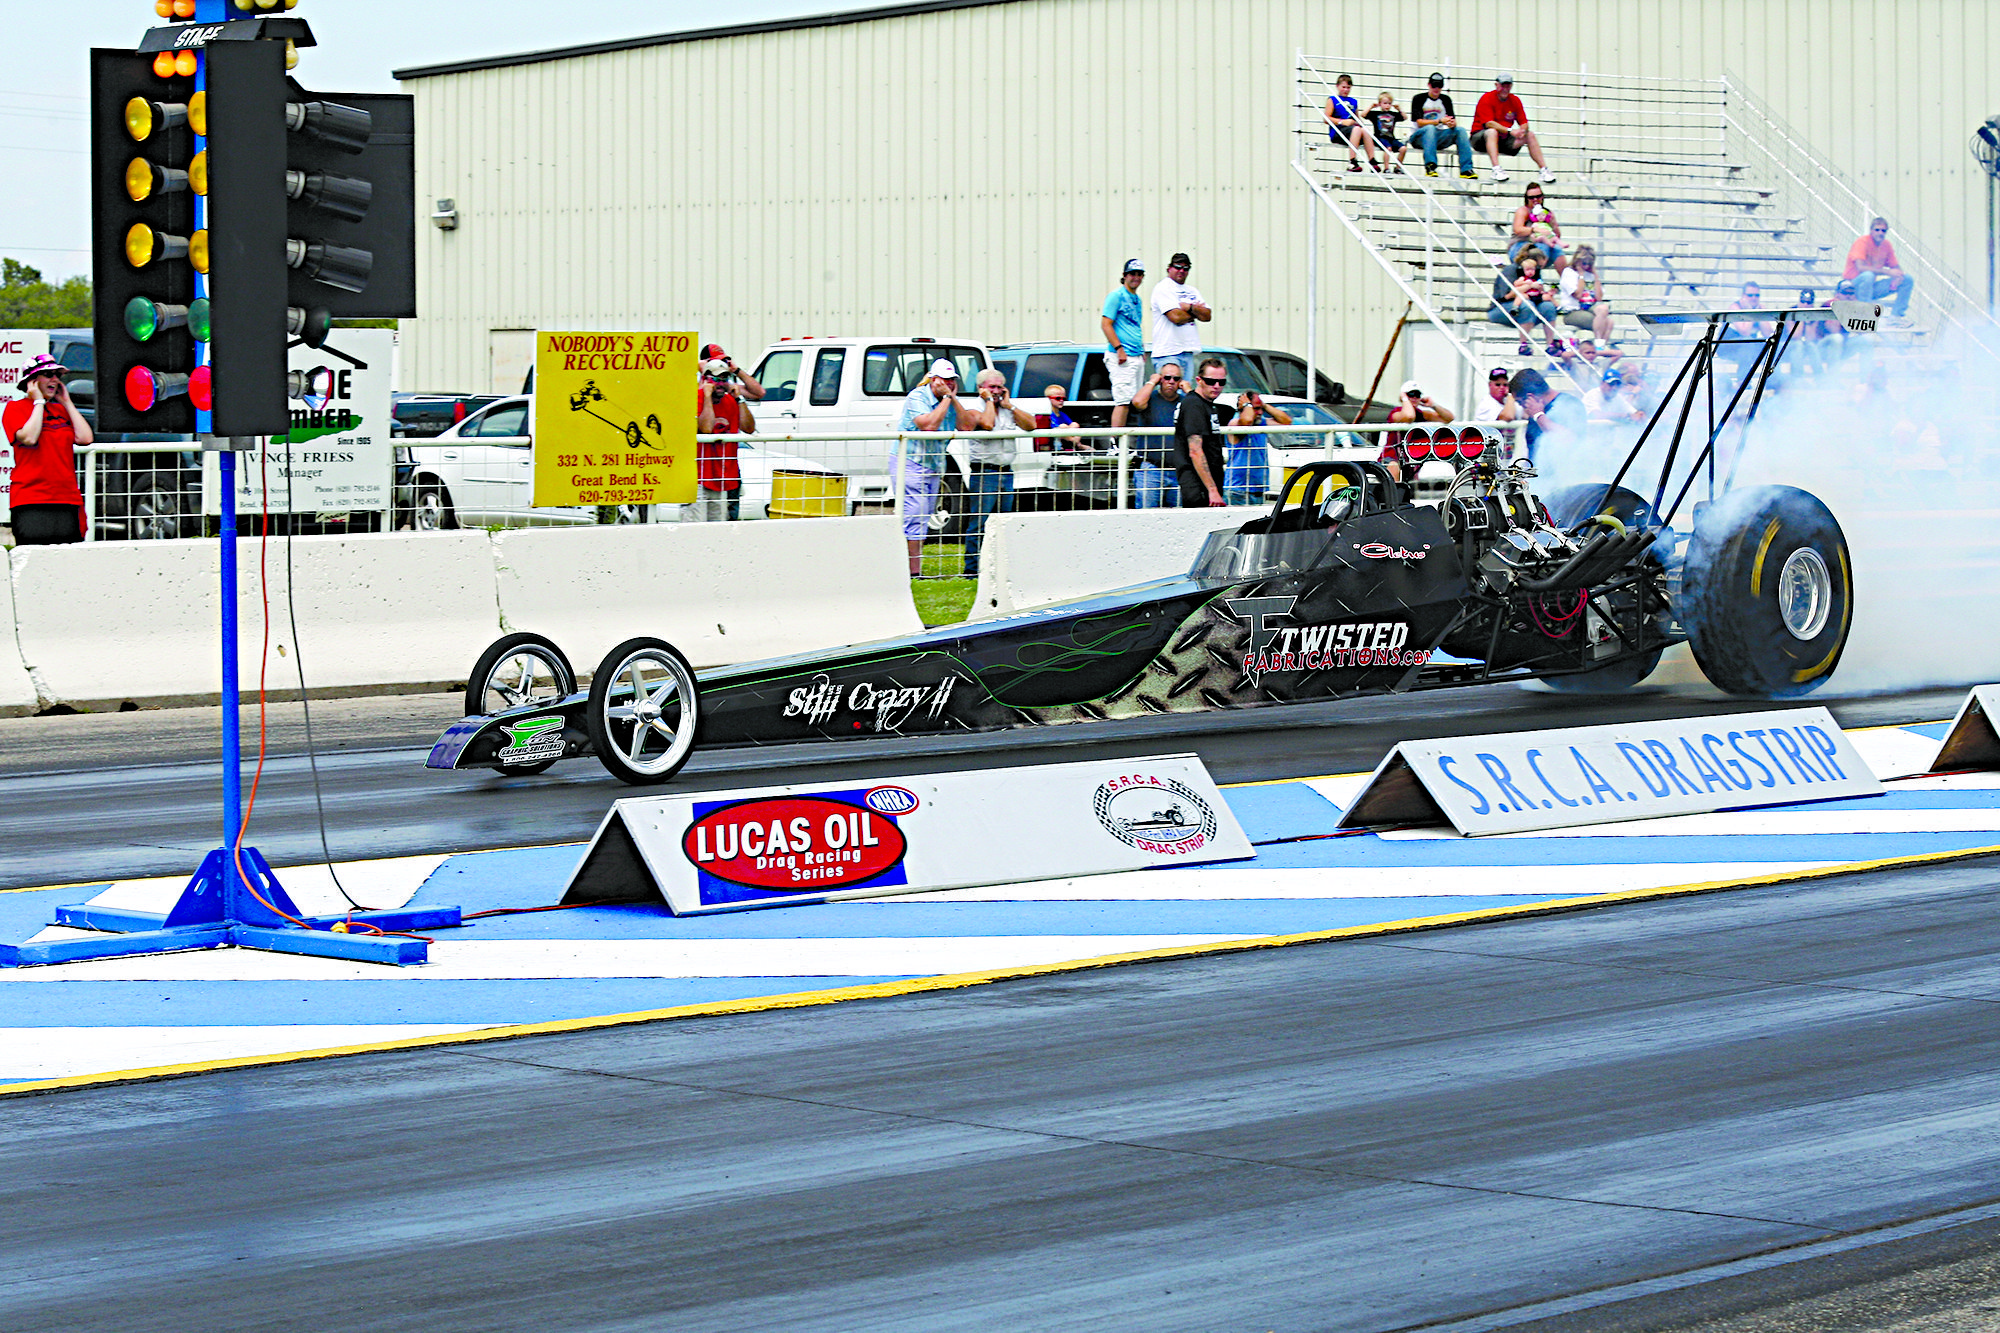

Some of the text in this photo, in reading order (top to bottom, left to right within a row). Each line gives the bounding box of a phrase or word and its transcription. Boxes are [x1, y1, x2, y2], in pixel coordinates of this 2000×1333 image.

[1847, 318, 1876, 332] 4764
[0, 341, 22, 354] MC
[547, 335, 690, 352] NOBODY'S AUTO
[563, 353, 666, 371] RECYCLING
[289, 408, 351, 429] MBER
[337, 437, 354, 445] Since
[249, 452, 354, 463] VNCE FRIESS
[557, 453, 675, 468] 332 N. 281 Highway
[571, 473, 661, 487] Great Bend Ks.
[579, 488, 655, 503] 620-793-2257
[1280, 622, 1409, 656] TWISTED
[848, 682, 931, 733] Crazy
[1437, 724, 1848, 817] S.R.C.A. DRAGSTRIP
[1108, 774, 1166, 791] S.R.C.A.
[870, 790, 913, 812] NHRA
[697, 812, 879, 863] LUCAS OIL
[1135, 838, 1177, 855] DRAG
[1176, 833, 1205, 855] STRIP
[756, 849, 862, 870] Drag Racing
[791, 865, 844, 882] Series
